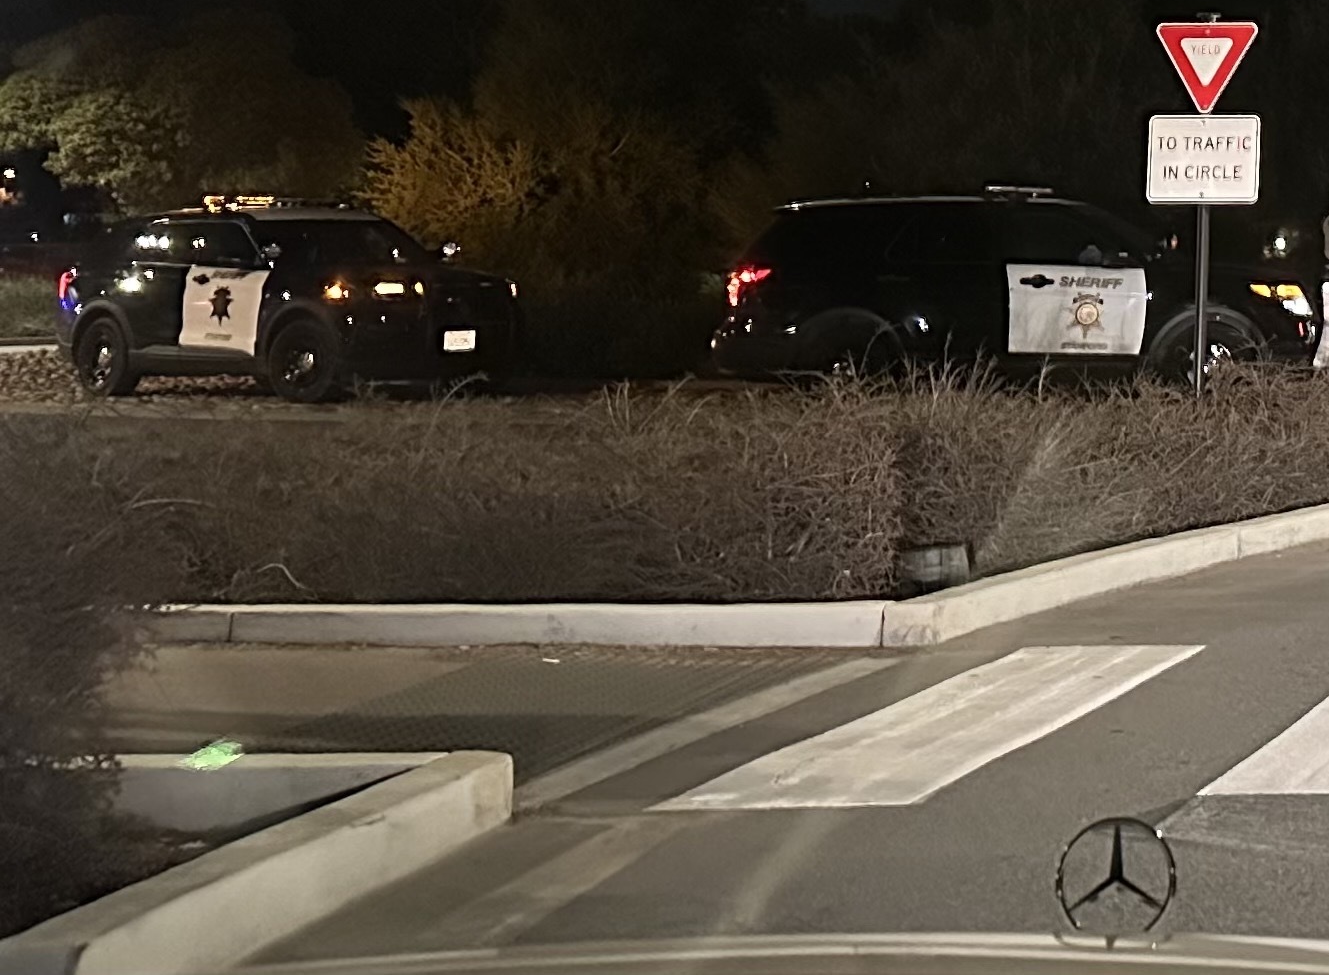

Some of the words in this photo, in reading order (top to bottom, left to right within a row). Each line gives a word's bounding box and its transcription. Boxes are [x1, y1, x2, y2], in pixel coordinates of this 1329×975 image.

[1191, 44, 1221, 56] YIELD
[1158, 136, 1177, 151] TO
[1184, 136, 1251, 152] TRAFFIC
[1163, 166, 1179, 180] IN
[1184, 165, 1242, 180] CIRCLE
[1059, 276, 1124, 289] SHERIFF
